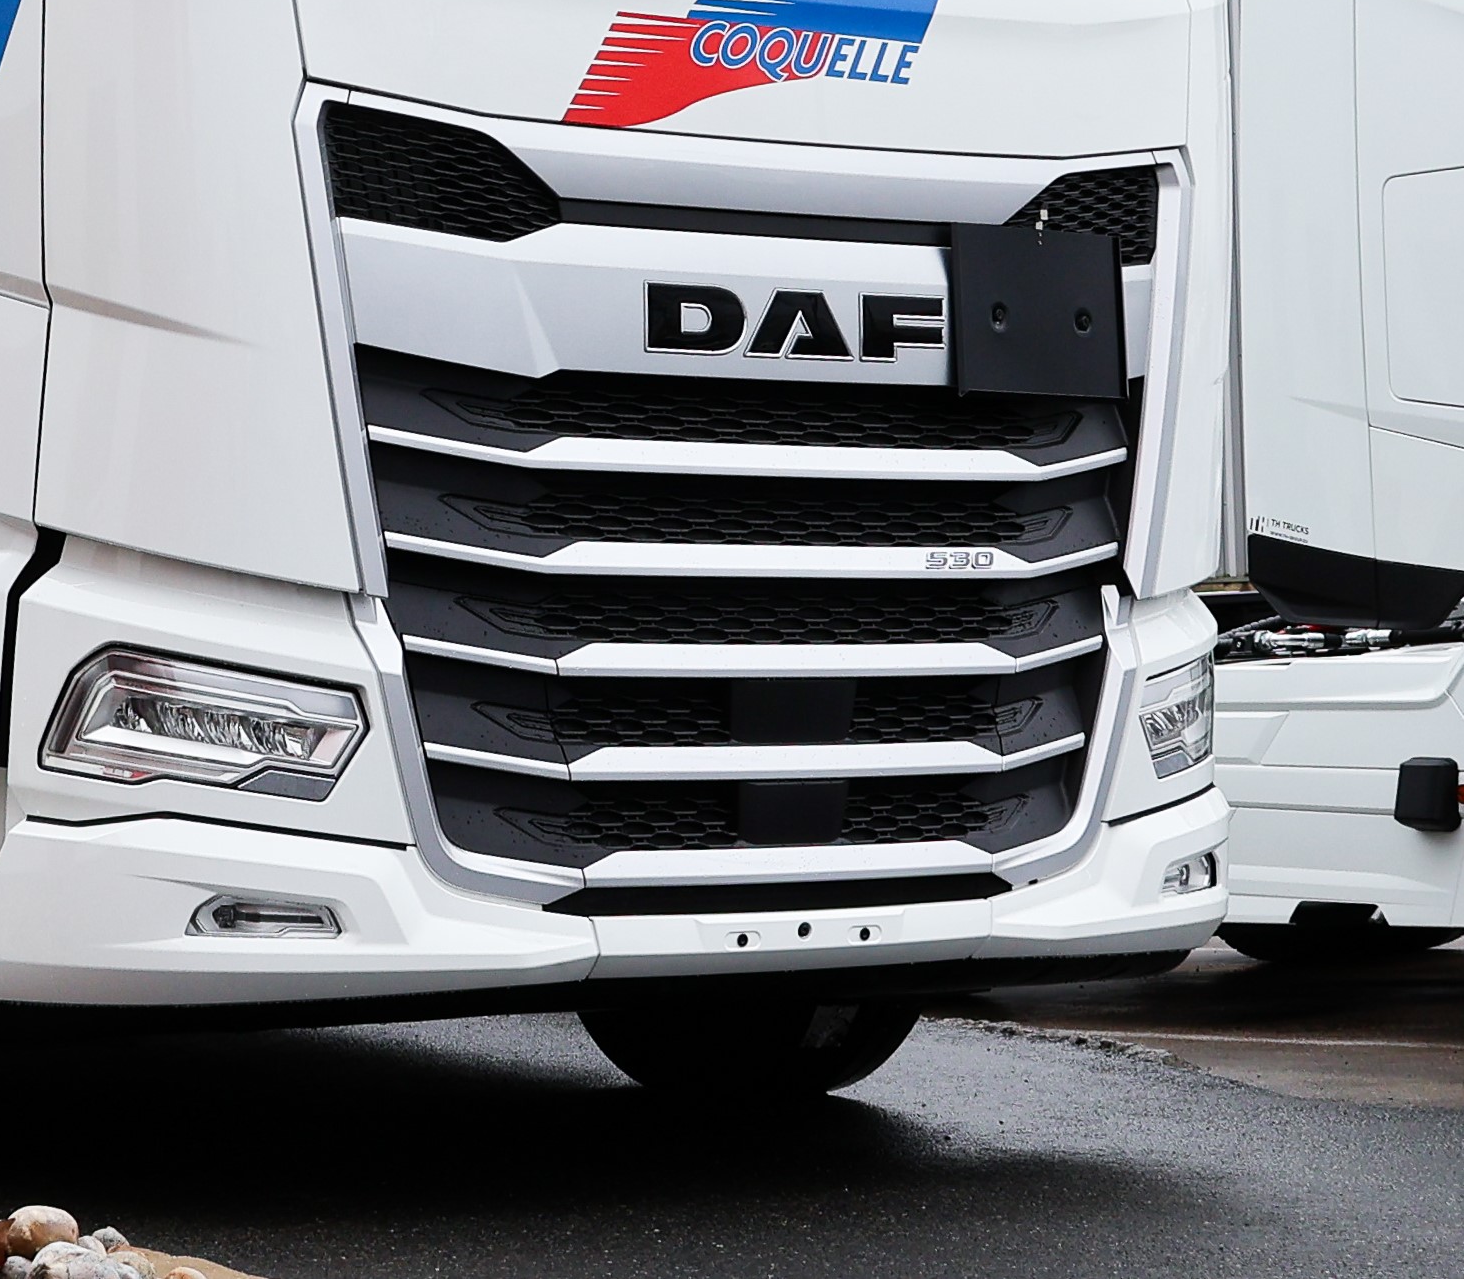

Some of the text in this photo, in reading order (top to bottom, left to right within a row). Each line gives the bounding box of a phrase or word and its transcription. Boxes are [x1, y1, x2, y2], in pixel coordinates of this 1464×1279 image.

[690, 20, 920, 84] COQUELLE
[643, 280, 947, 362] DAF
[925, 551, 994, 570] 530
